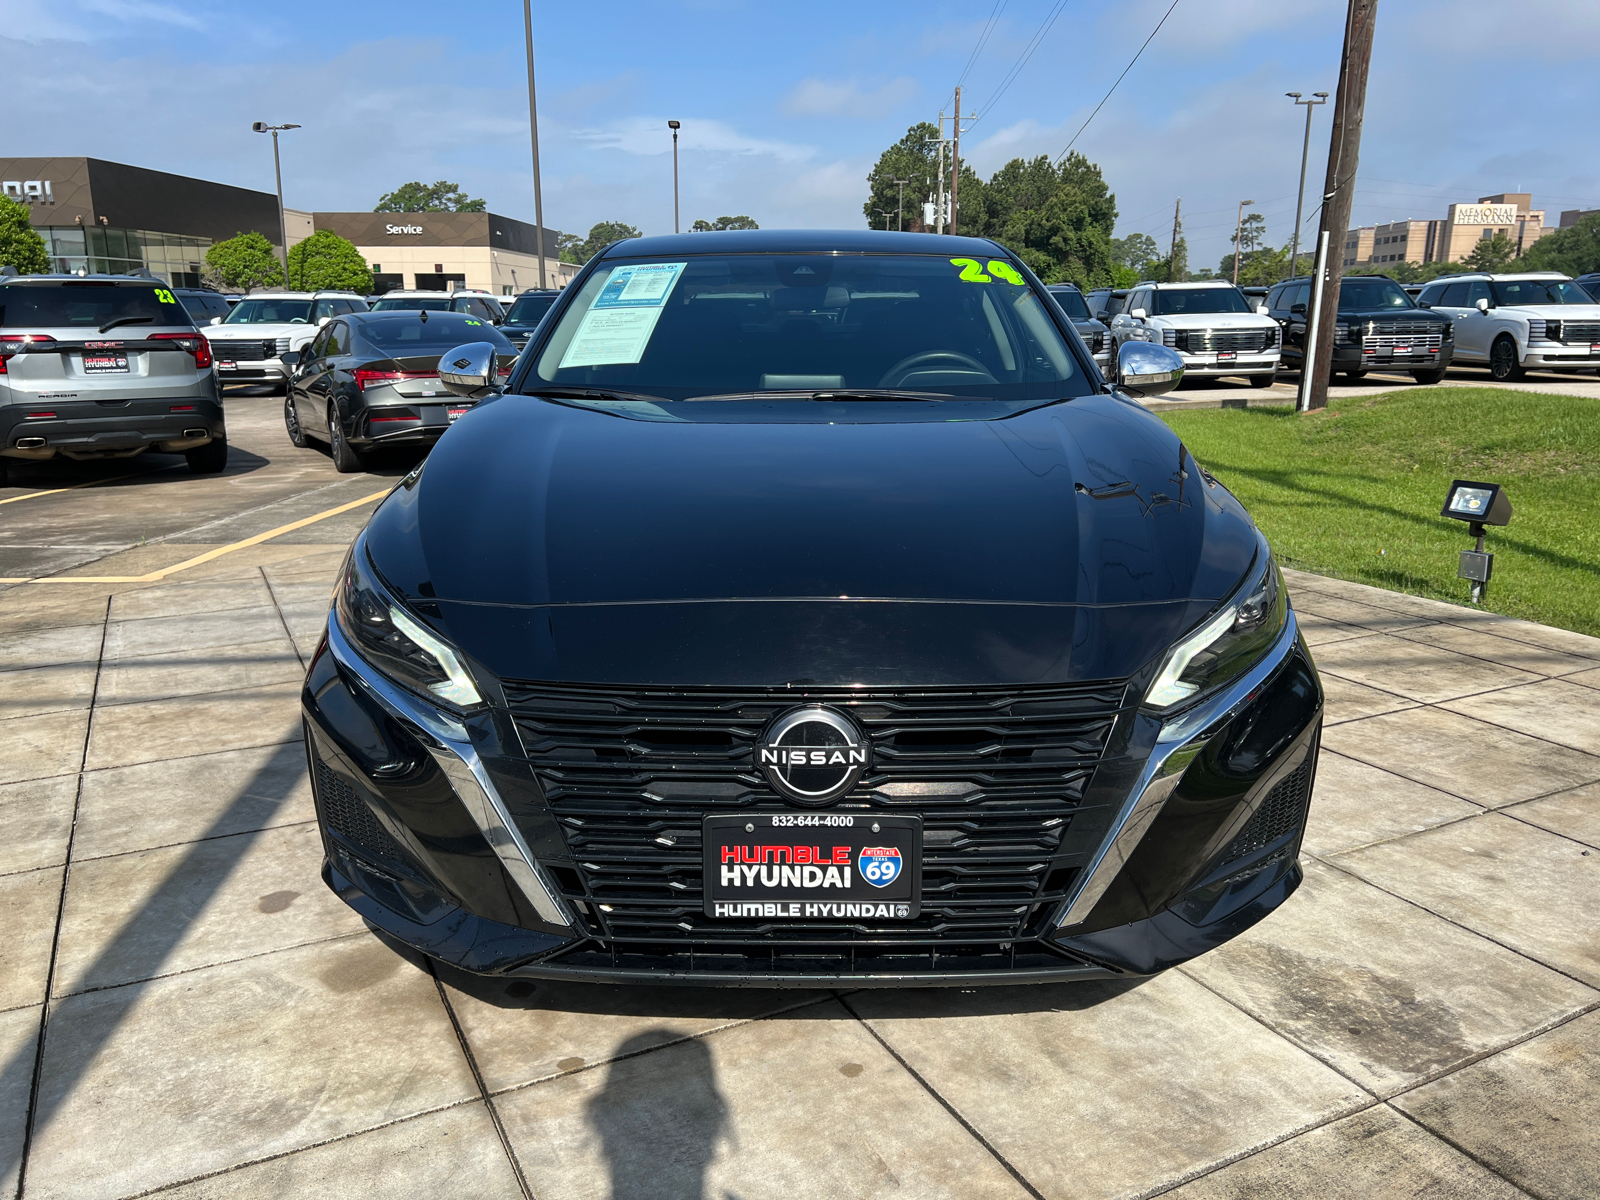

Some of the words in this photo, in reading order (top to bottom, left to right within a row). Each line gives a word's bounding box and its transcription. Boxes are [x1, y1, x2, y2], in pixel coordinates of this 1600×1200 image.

[0, 181, 53, 202] DAI
[1457, 214, 1514, 223] HERMANN
[1458, 207, 1514, 217] MEMORIAL
[386, 224, 423, 235] Service
[949, 258, 1026, 285] 24
[154, 288, 176, 304] 23
[85, 341, 124, 349] GMC
[761, 749, 866, 765] NISSAN
[771, 816, 854, 827] 832-644-4000
[721, 845, 851, 865] HUMBLE
[720, 864, 852, 888] HYUNDAI
[866, 861, 896, 880] 69
[715, 903, 801, 917] HUMBLE
[805, 904, 895, 918] HYUNDAI
[898, 909, 907, 917] 69
